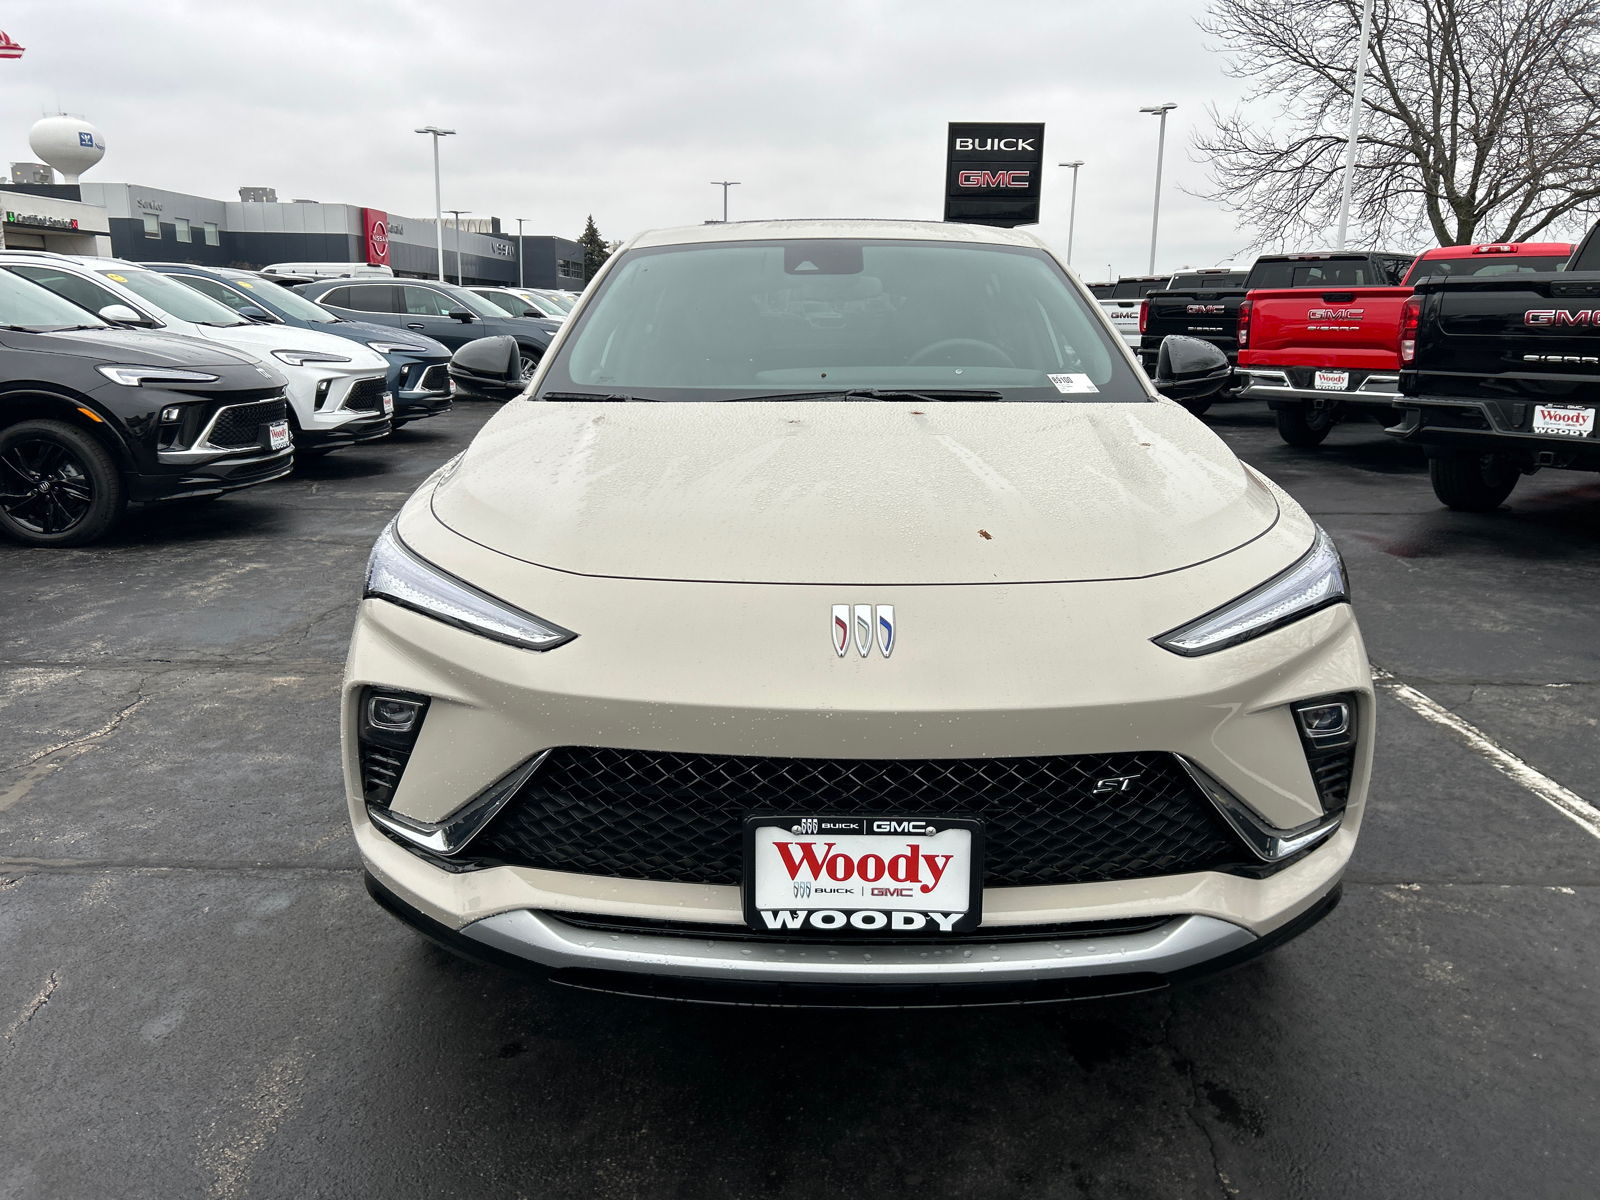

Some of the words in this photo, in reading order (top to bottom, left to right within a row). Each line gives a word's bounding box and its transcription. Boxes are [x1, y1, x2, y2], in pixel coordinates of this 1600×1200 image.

[955, 138, 1035, 151] BUICK
[958, 170, 1030, 188] GMC
[137, 198, 163, 212] Service
[372, 234, 388, 243] NISSAN
[491, 241, 515, 257] NISSAN
[1110, 311, 1139, 319] GMC
[1187, 304, 1225, 314] GMC
[1307, 308, 1365, 321] GMC
[1524, 309, 1600, 327] GM
[1318, 373, 1347, 385] Woody
[1540, 409, 1590, 427] Woody
[1533, 427, 1591, 438] WOODY
[1092, 774, 1141, 794] ST
[821, 822, 859, 830] BUICK
[873, 821, 926, 833] GMC
[772, 841, 954, 894] Woody
[814, 887, 855, 895] BUICK
[870, 887, 914, 898] GMC
[760, 910, 965, 932] WOODY
